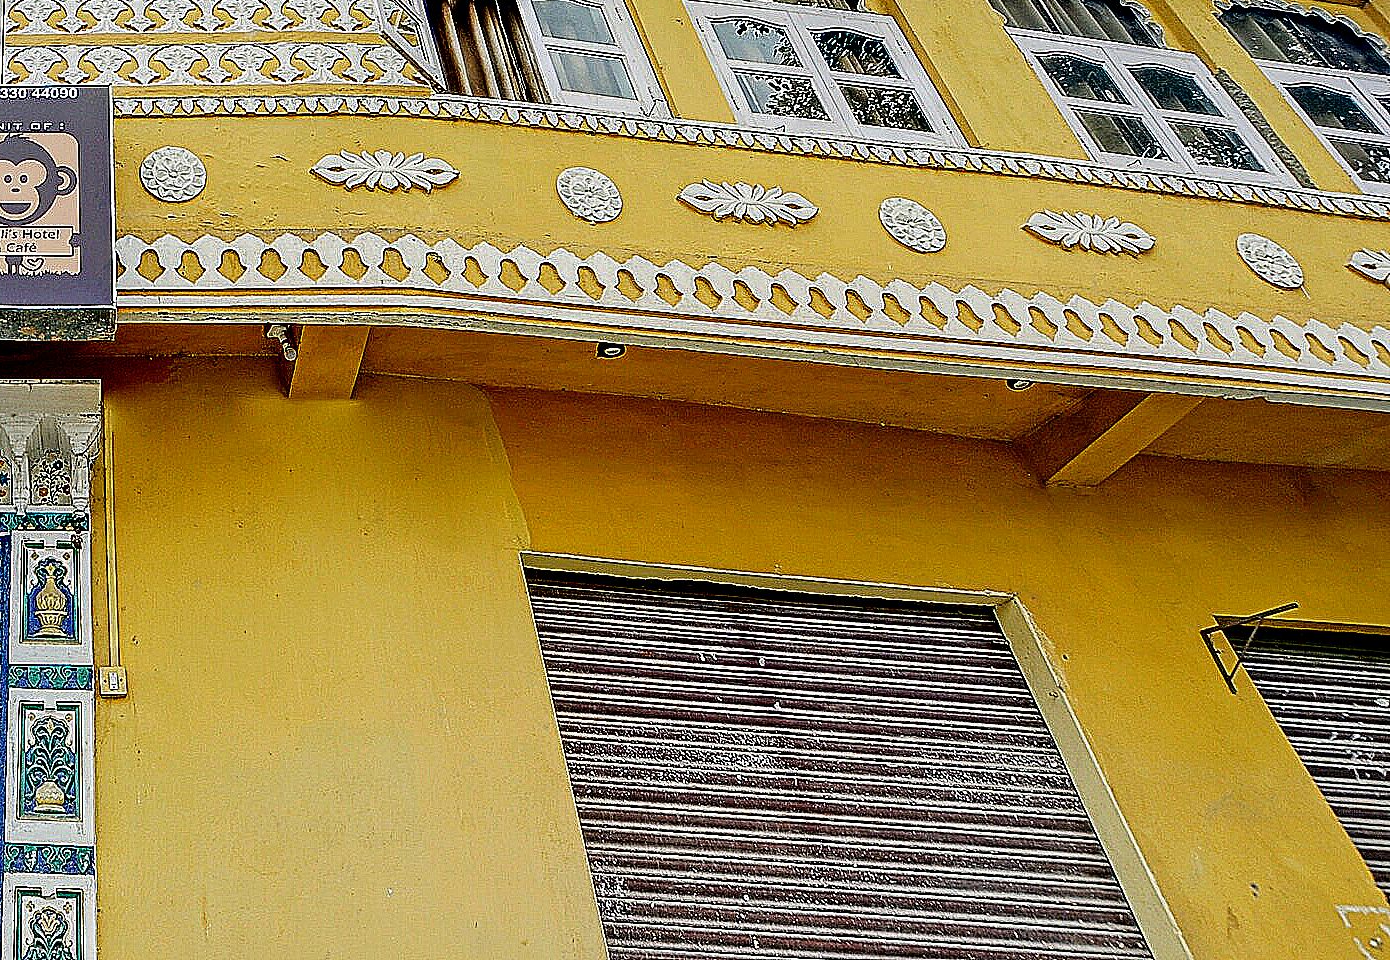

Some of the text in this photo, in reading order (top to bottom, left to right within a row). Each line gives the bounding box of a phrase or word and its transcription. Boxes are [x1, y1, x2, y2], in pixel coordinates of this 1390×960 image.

[31, 88, 78, 100] 44090
[30, 122, 53, 131] OF
[22, 229, 60, 240] Hotel
